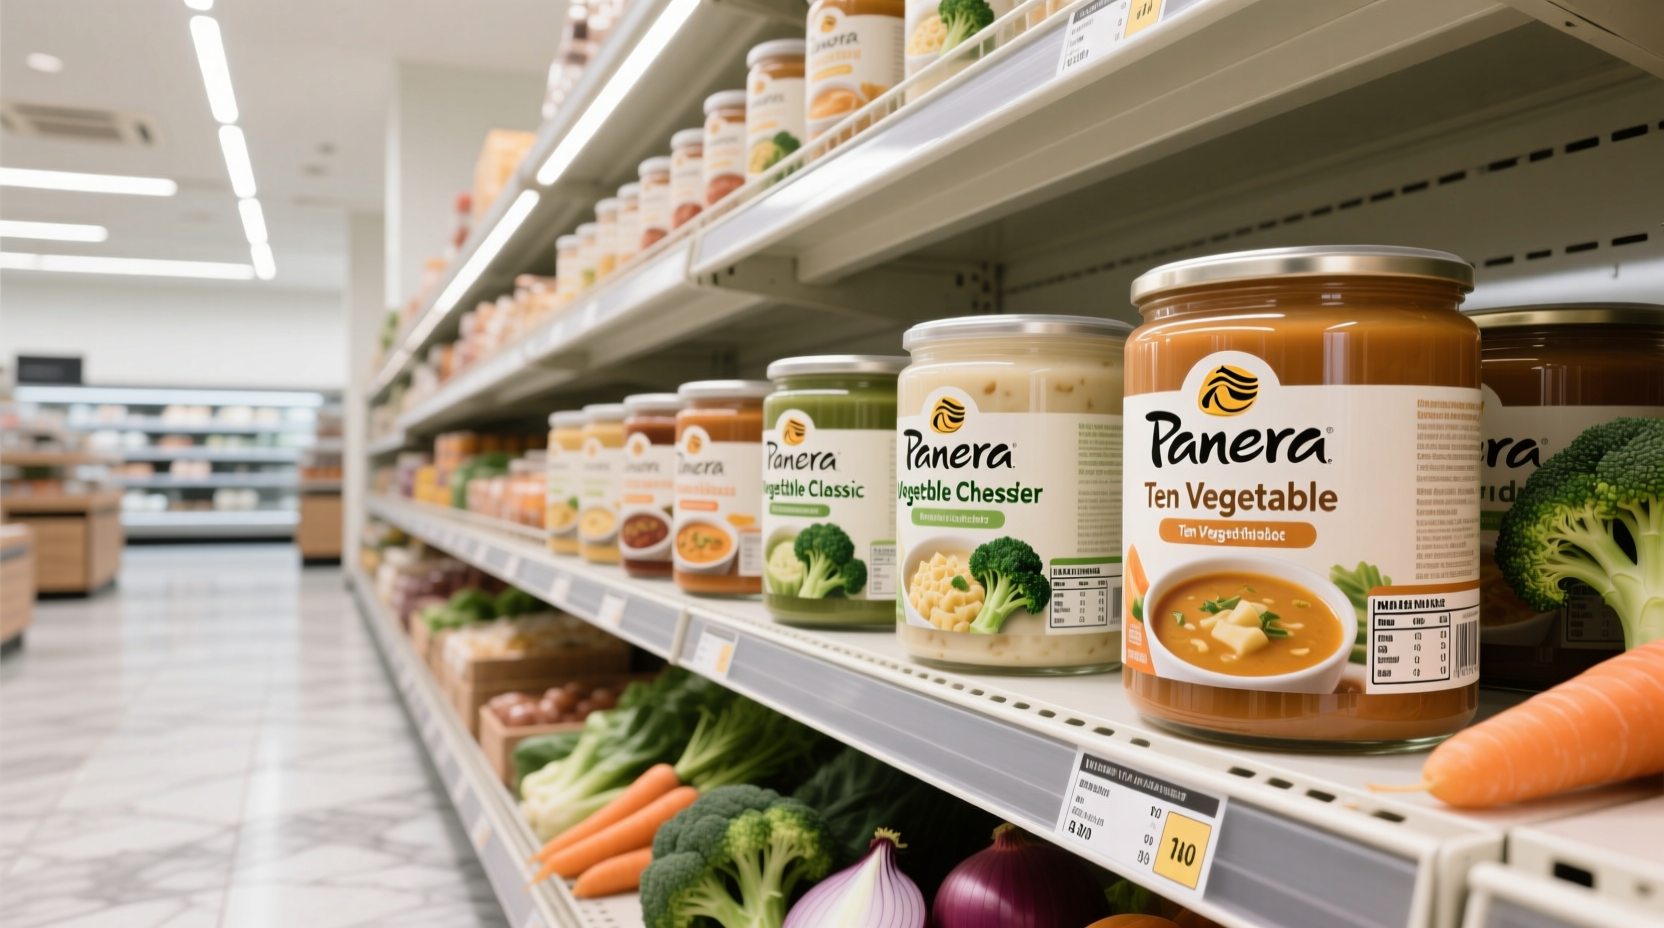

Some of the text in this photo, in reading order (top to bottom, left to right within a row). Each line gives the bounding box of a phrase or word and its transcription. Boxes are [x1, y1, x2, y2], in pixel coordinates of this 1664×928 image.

[904, 429, 1013, 470] Panera
[1145, 410, 1327, 468] Panera
[1481, 437, 1541, 468] ra
[767, 441, 836, 471] Panera
[809, 479, 864, 498] Classic
[1145, 481, 1338, 517] Ten Vegetable
